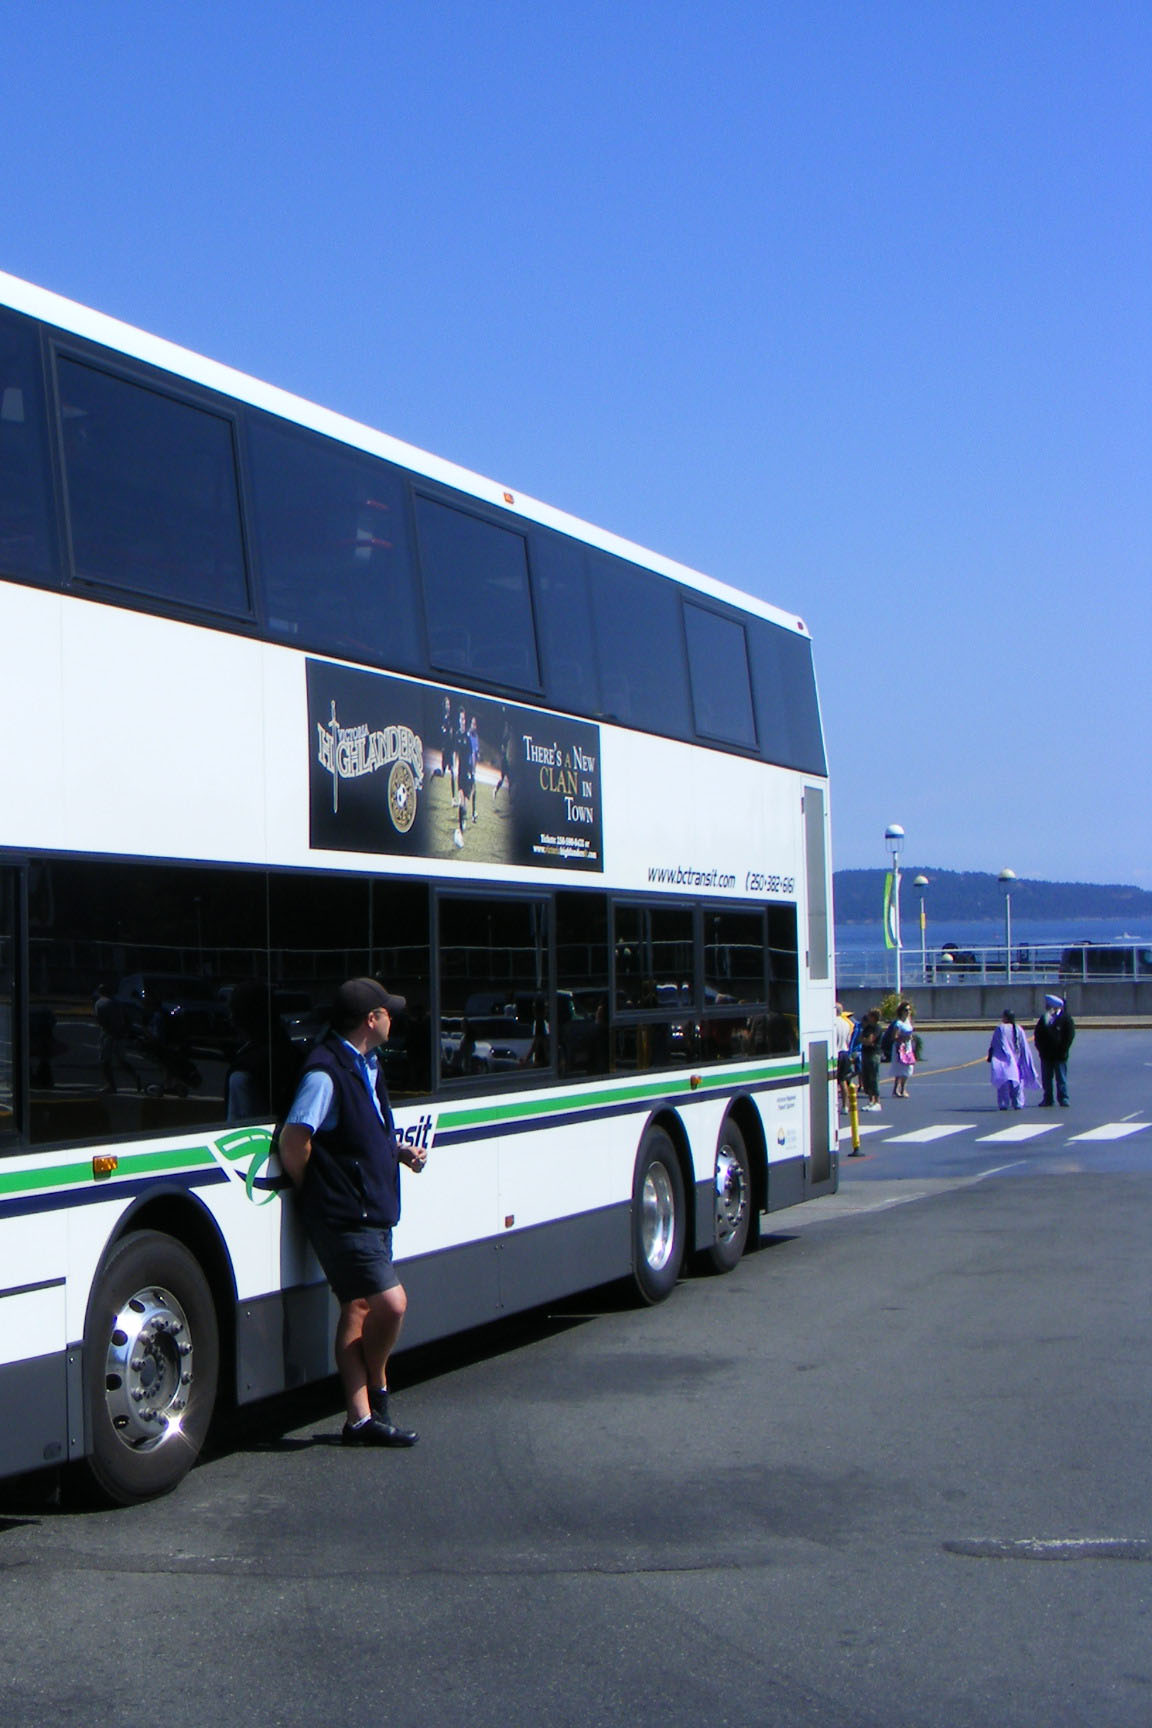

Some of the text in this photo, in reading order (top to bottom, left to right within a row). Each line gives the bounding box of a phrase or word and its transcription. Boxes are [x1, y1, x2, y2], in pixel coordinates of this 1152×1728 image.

[317, 722, 424, 782] HIGHLANDERS
[523, 735, 595, 772] THERE'S A NEW
[539, 766, 592, 798] CLAN IN
[564, 796, 594, 823] TOWN
[648, 865, 736, 889] www.bctransit.com
